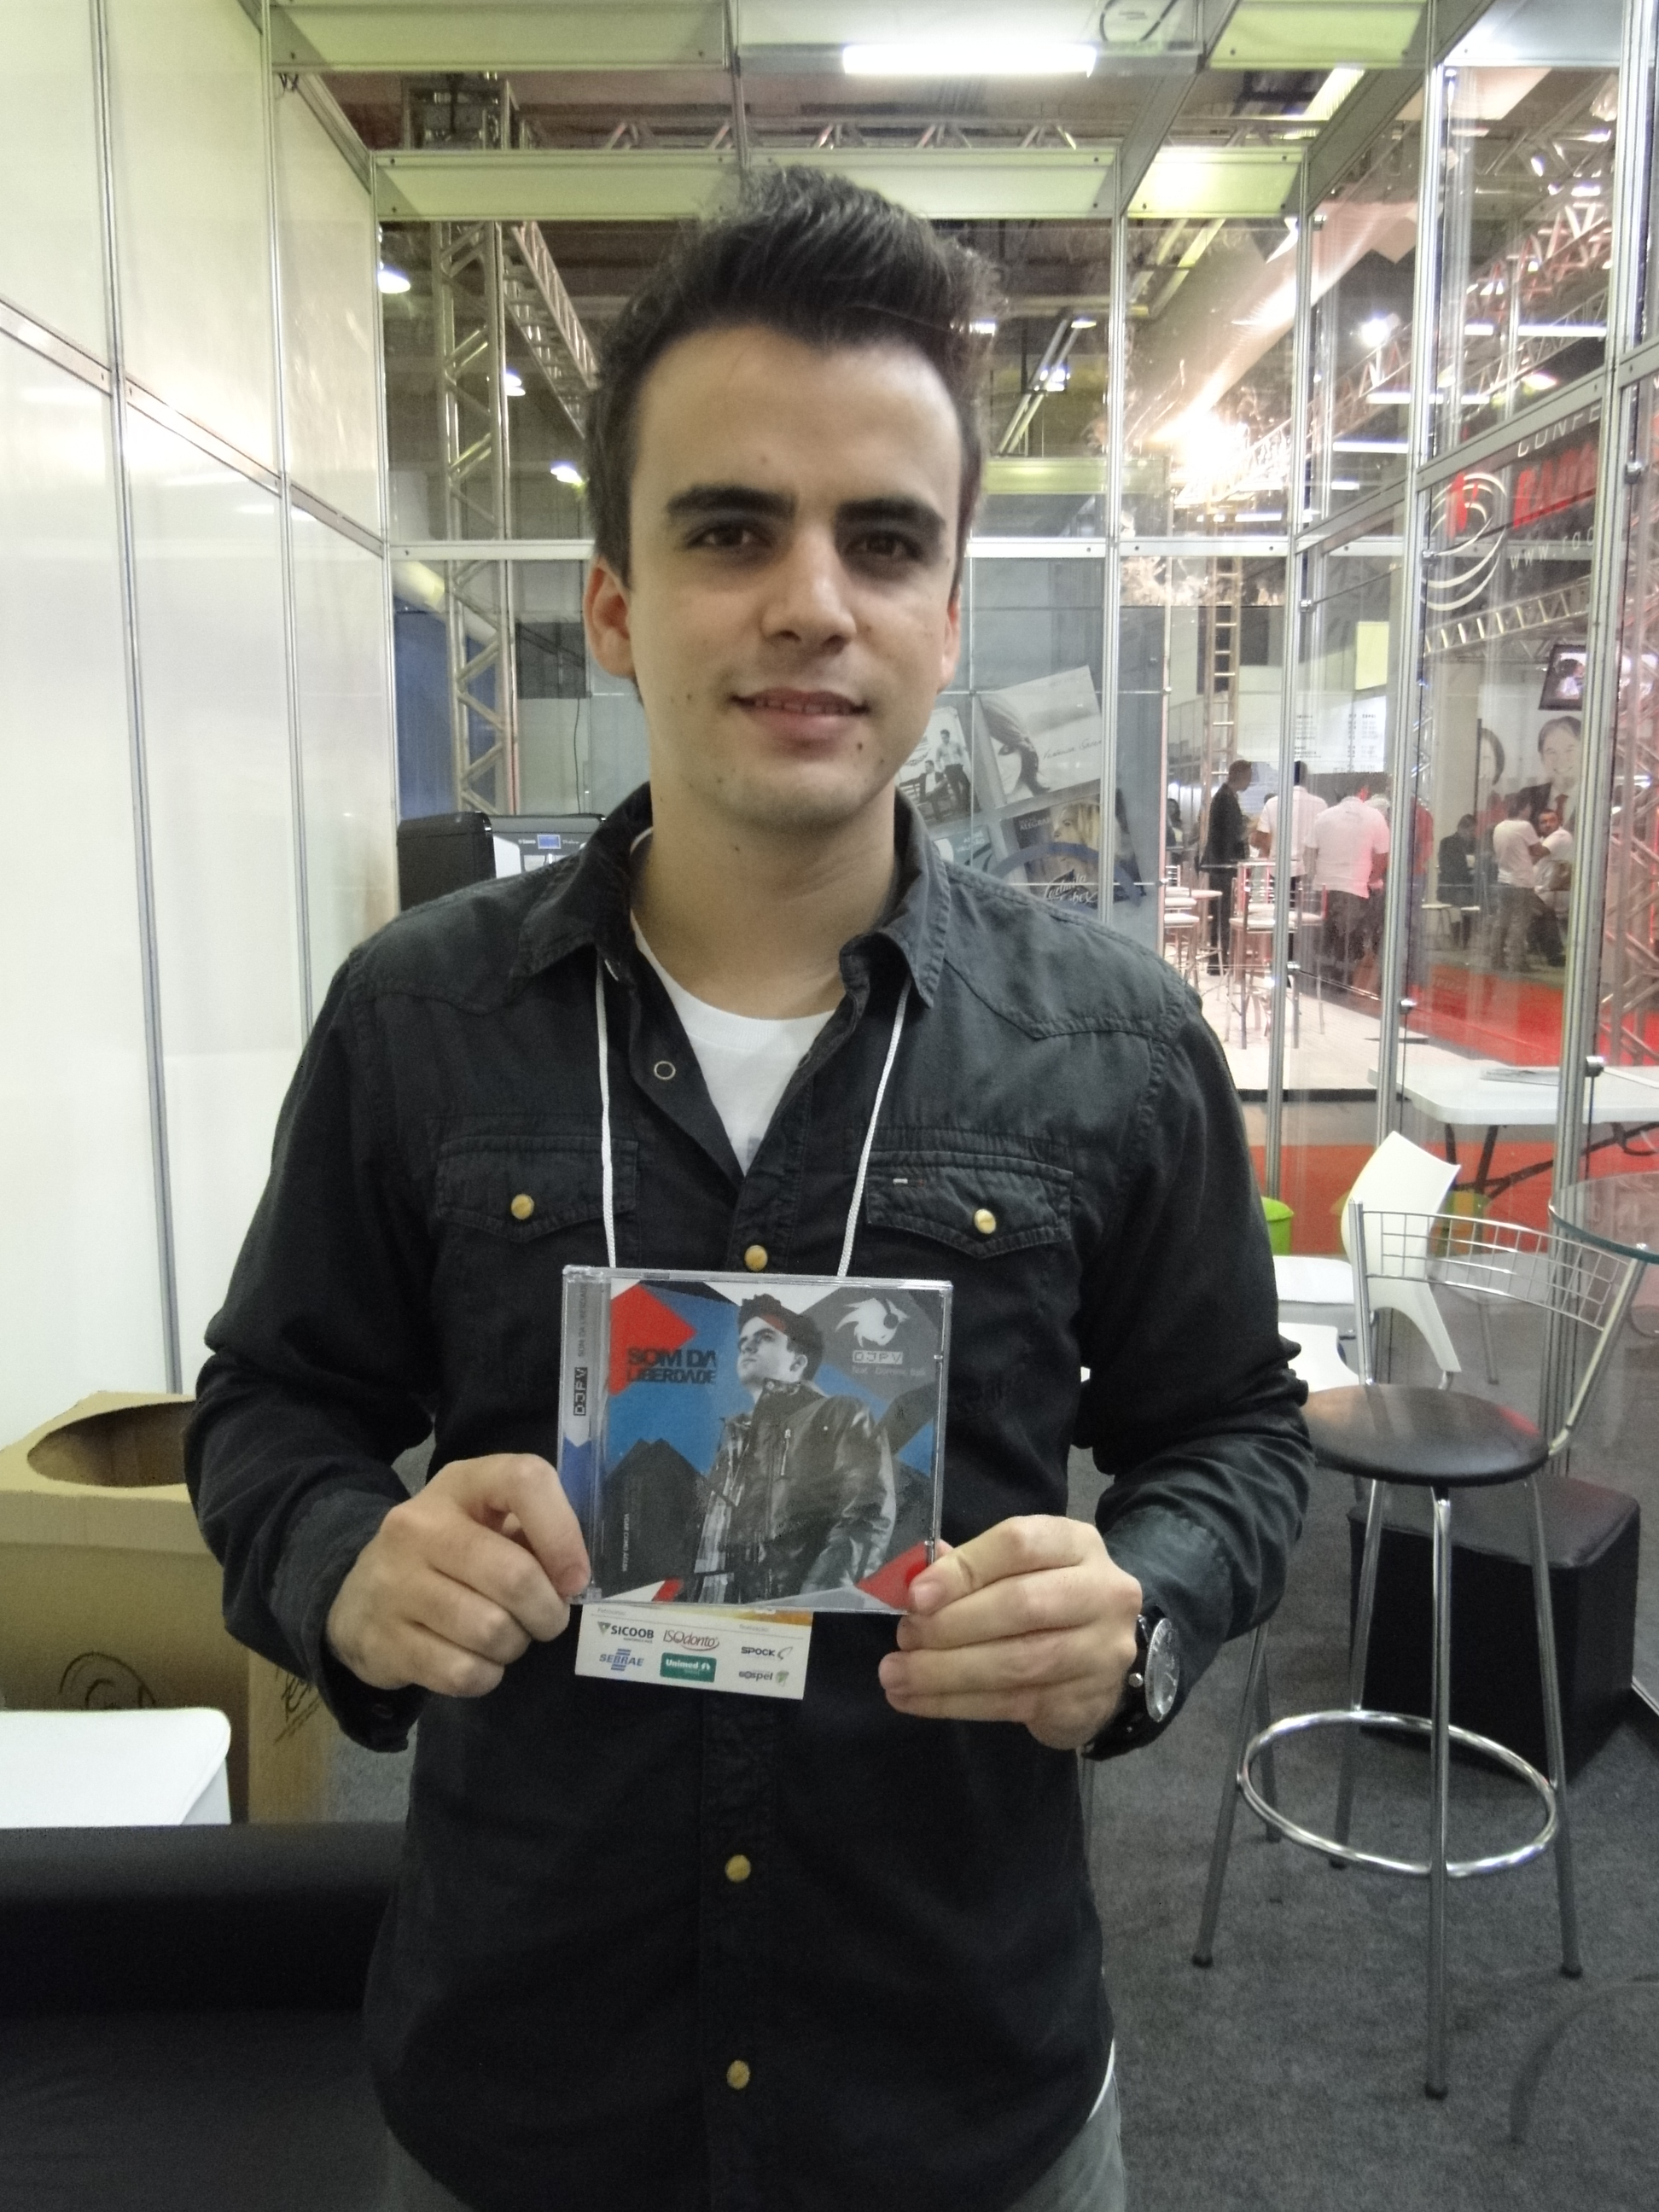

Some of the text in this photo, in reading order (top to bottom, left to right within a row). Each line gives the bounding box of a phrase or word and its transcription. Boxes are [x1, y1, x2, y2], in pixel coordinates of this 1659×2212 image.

[627, 1348, 716, 1368] SOM DA
[626, 1366, 716, 1383] LIBERDADE
[610, 1625, 655, 1639] SICOOB
[741, 1645, 776, 1656] SPOCK
[598, 1653, 644, 1667] SEBRAE
[666, 1658, 700, 1669] Unimed
